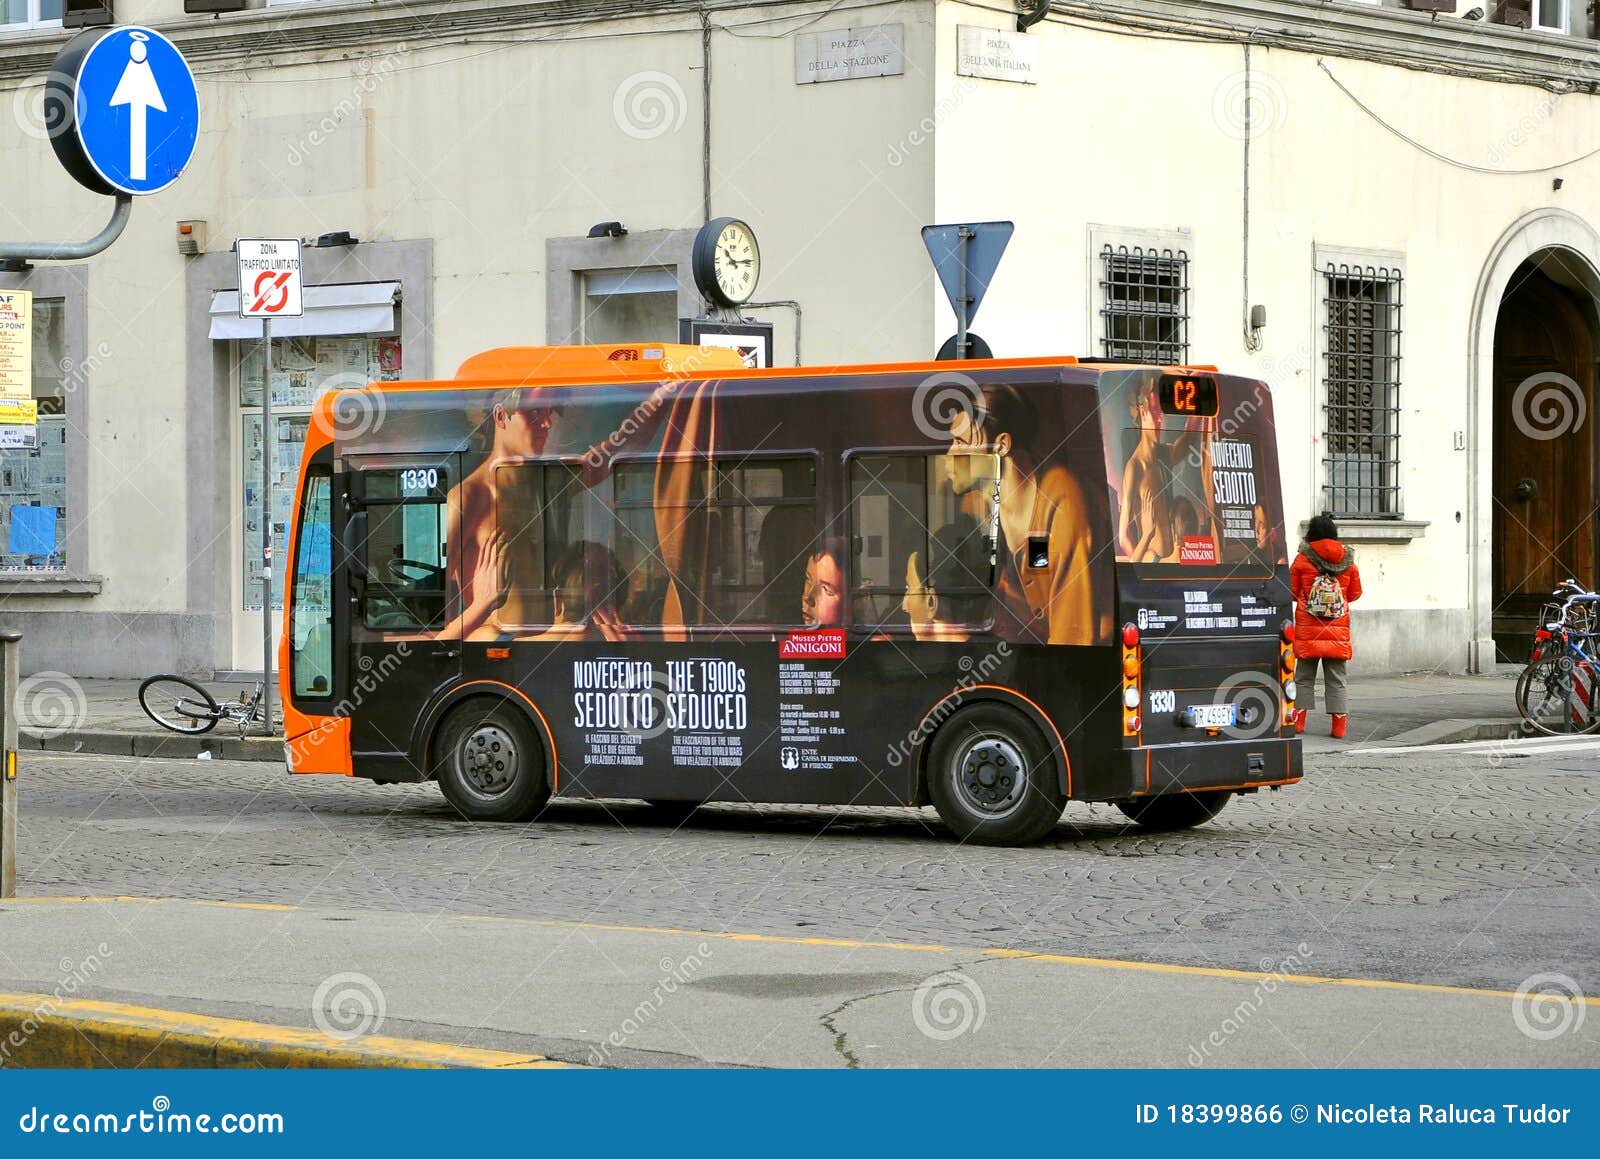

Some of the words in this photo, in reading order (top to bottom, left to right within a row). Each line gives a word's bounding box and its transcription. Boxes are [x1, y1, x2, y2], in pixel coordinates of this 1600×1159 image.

[831, 39, 865, 50] PIAZZA
[987, 39, 1011, 49] PIAZZA
[808, 58, 839, 72] DELLA
[843, 54, 889, 68] STAZIONE
[1003, 60, 1031, 72] ITALIANA
[260, 243, 278, 255] ZONA
[241, 259, 270, 270] TRAFFICO
[271, 259, 299, 270] LIMITATO
[5, 322, 25, 330] POINT
[1173, 380, 1196, 411] C2
[1210, 441, 1253, 469] NOVECENTO
[400, 468, 438, 490] 1330
[1212, 470, 1257, 505] SEDOTTO
[1181, 547, 1214, 561] ANNIGONI
[783, 640, 842, 653] ANNIGONI
[792, 634, 816, 642] MUSEO
[817, 634, 842, 642] PIETRO
[573, 661, 653, 689] NOVECENTO
[665, 661, 695, 692] THE
[699, 661, 746, 693] 1900s
[573, 691, 653, 729] SEDOTTO
[1149, 689, 1176, 714] 1330
[666, 693, 748, 730] SEDUCED
